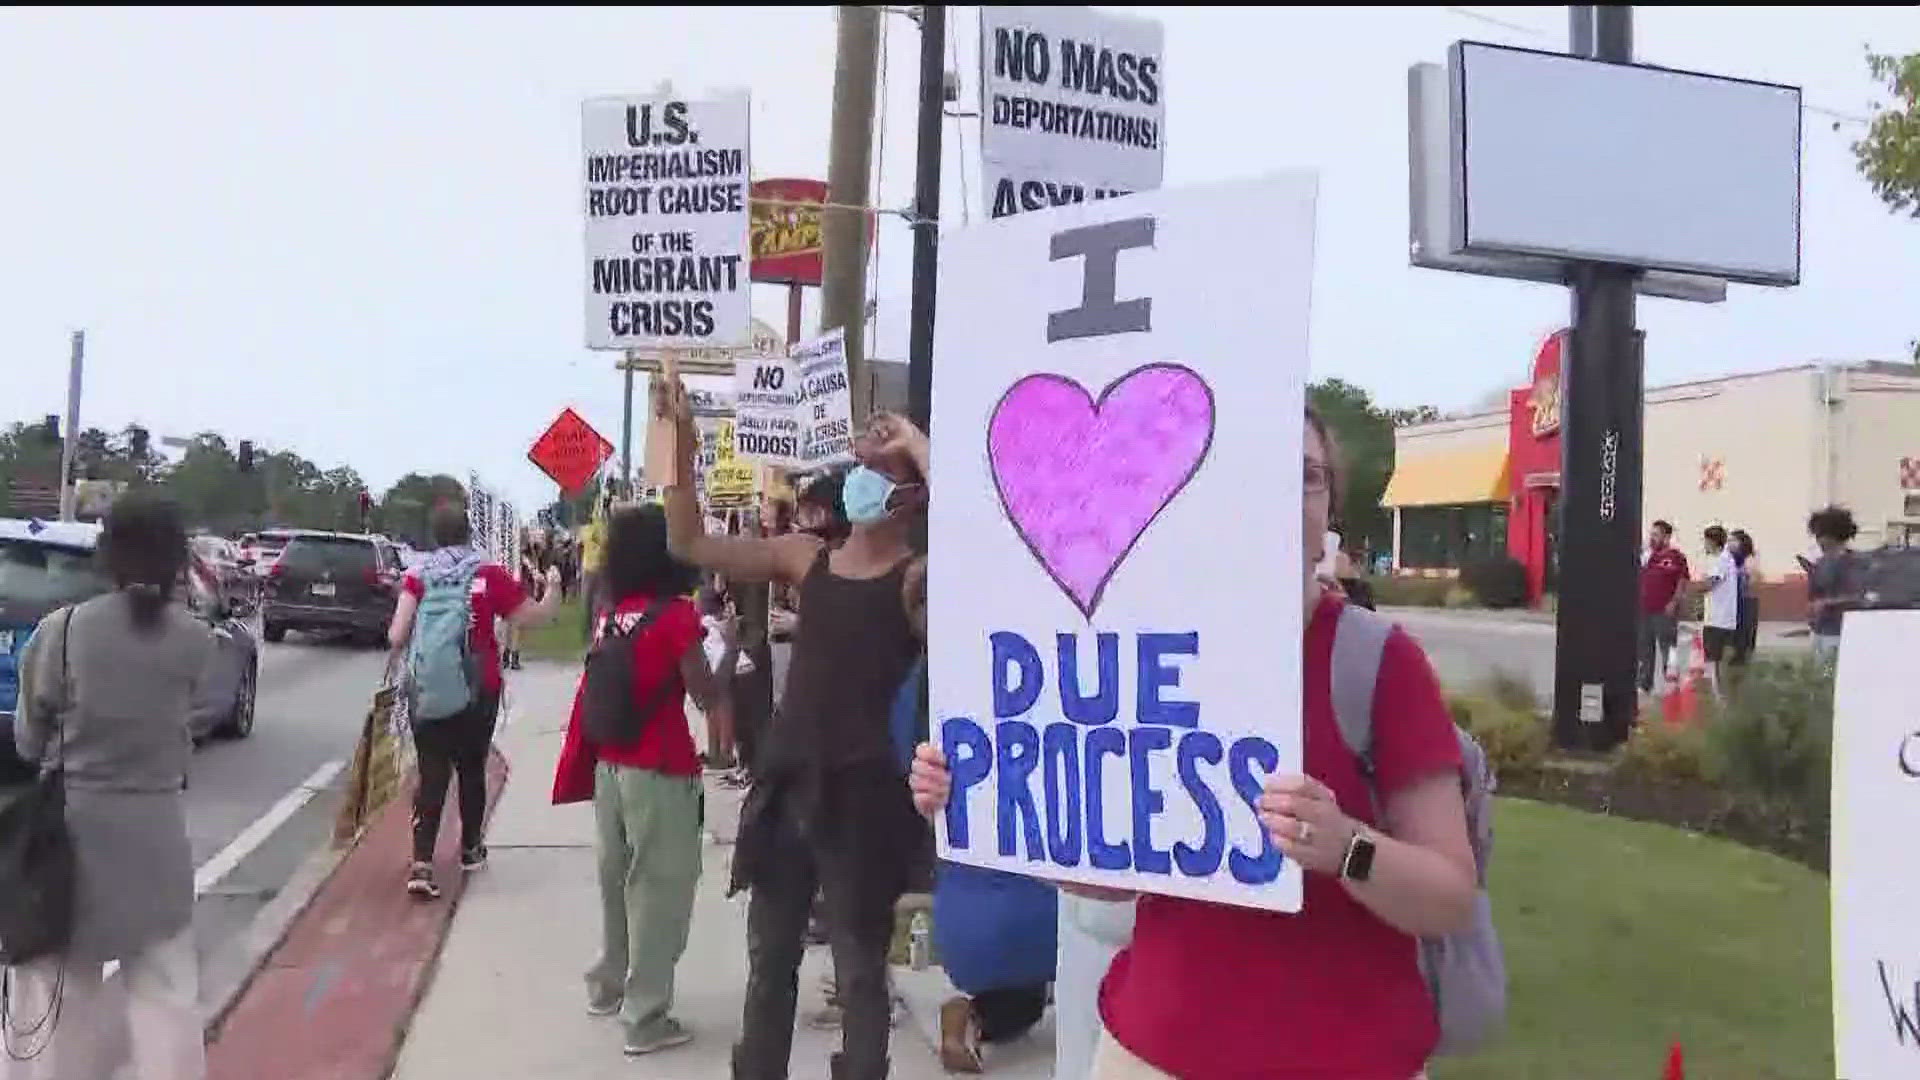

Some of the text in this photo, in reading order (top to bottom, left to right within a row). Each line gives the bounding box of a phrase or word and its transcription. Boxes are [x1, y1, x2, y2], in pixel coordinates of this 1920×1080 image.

[995, 27, 1158, 106] NO MASS
[626, 101, 698, 147] U.S.
[992, 94, 1158, 150] DEPORTATIONS!
[588, 148, 742, 182] IMPERIALISM
[590, 183, 743, 216] ROOT CAUSE
[632, 231, 694, 254] OF THE
[592, 254, 742, 294] MIGRANT
[1047, 214, 1158, 345] I
[609, 299, 715, 337] CRISIS
[753, 365, 784, 390] NO
[808, 372, 848, 398] CAUSA
[814, 402, 826, 420] DE
[737, 433, 798, 457] TODOS!
[990, 630, 1200, 728] DUE
[941, 716, 1283, 885] PROCESS
